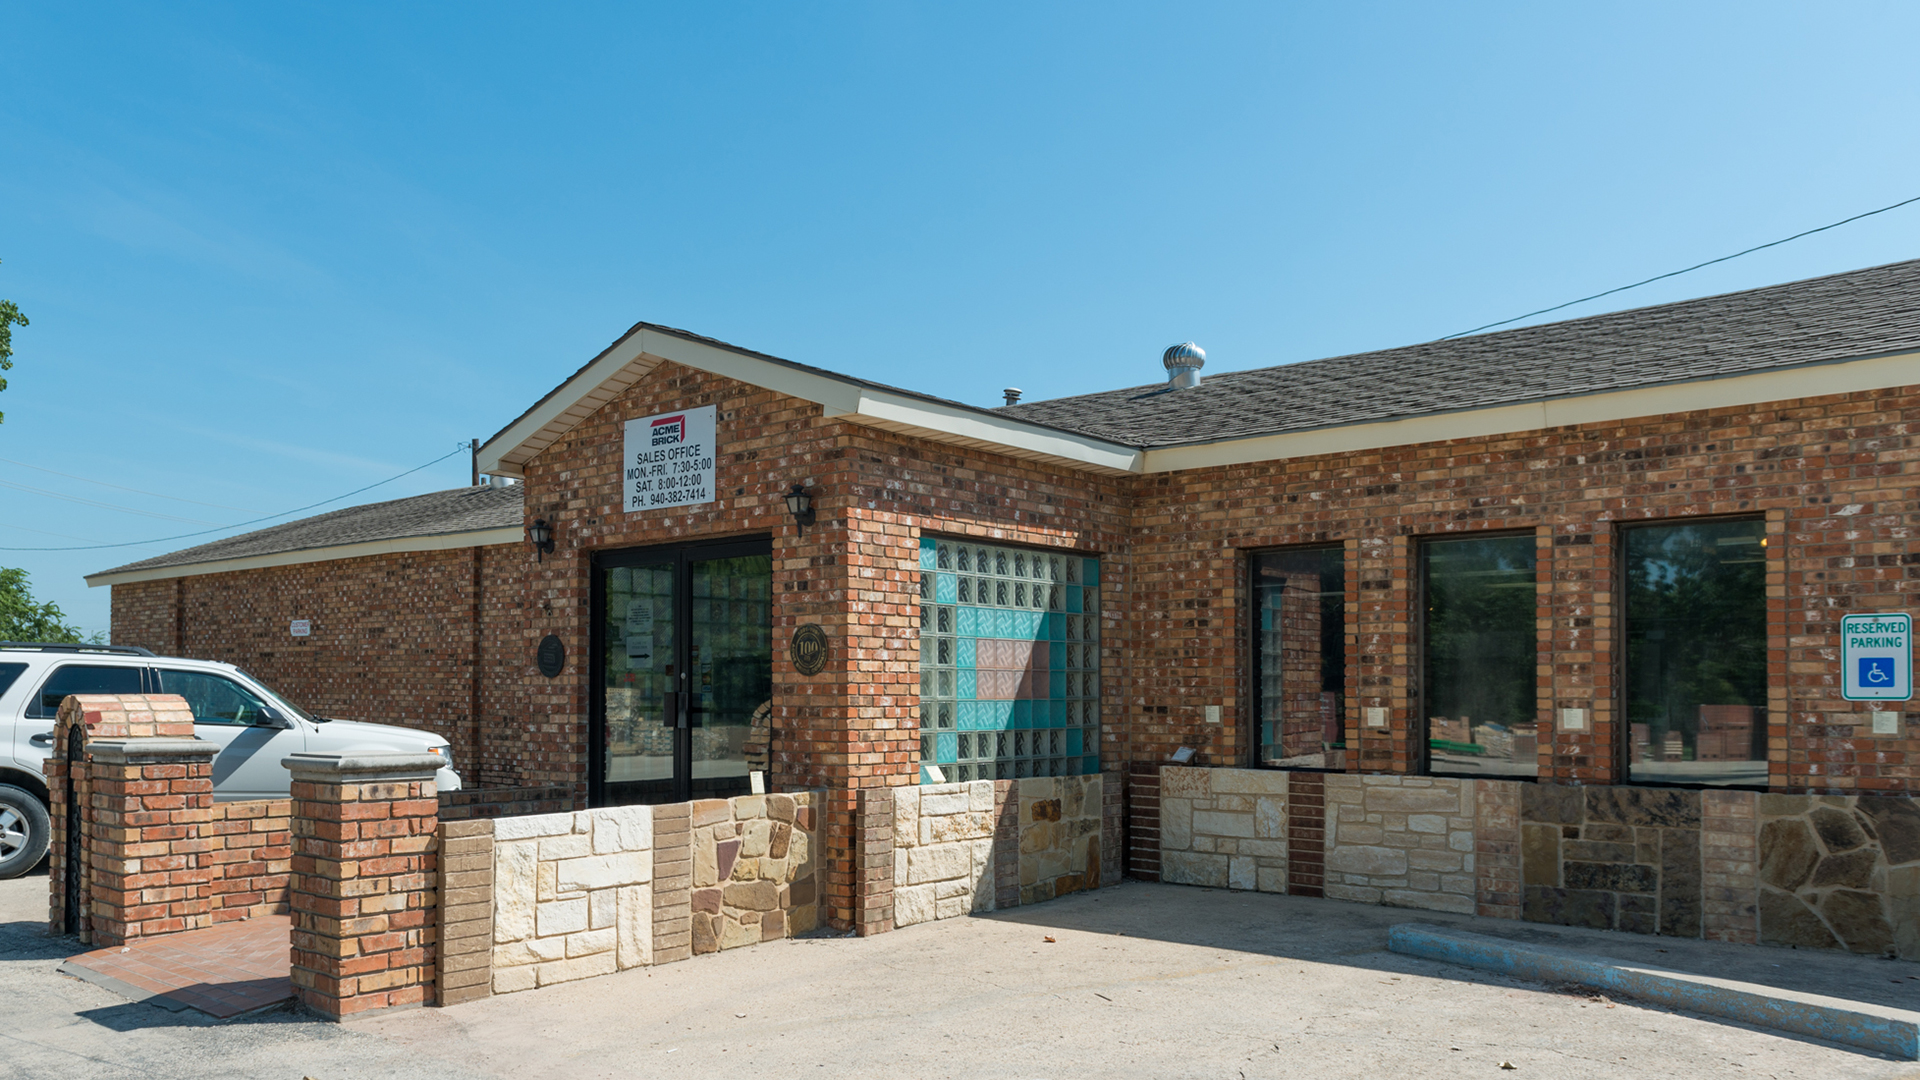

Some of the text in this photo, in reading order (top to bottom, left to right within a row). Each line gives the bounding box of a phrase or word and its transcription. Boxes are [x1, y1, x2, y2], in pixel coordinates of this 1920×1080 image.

[652, 424, 680, 436] ACME
[652, 434, 680, 446] BRICK
[637, 444, 700, 465] SALES OFFICE
[627, 458, 711, 480] MON.-FRI. 7:30-5:00
[636, 474, 701, 493] SAT. 8:00-12:00
[632, 488, 705, 507] PH. 940-382-7414
[1847, 622, 1906, 634] RESERVED
[799, 641, 818, 655] 100
[1851, 637, 1902, 648] PARKING
